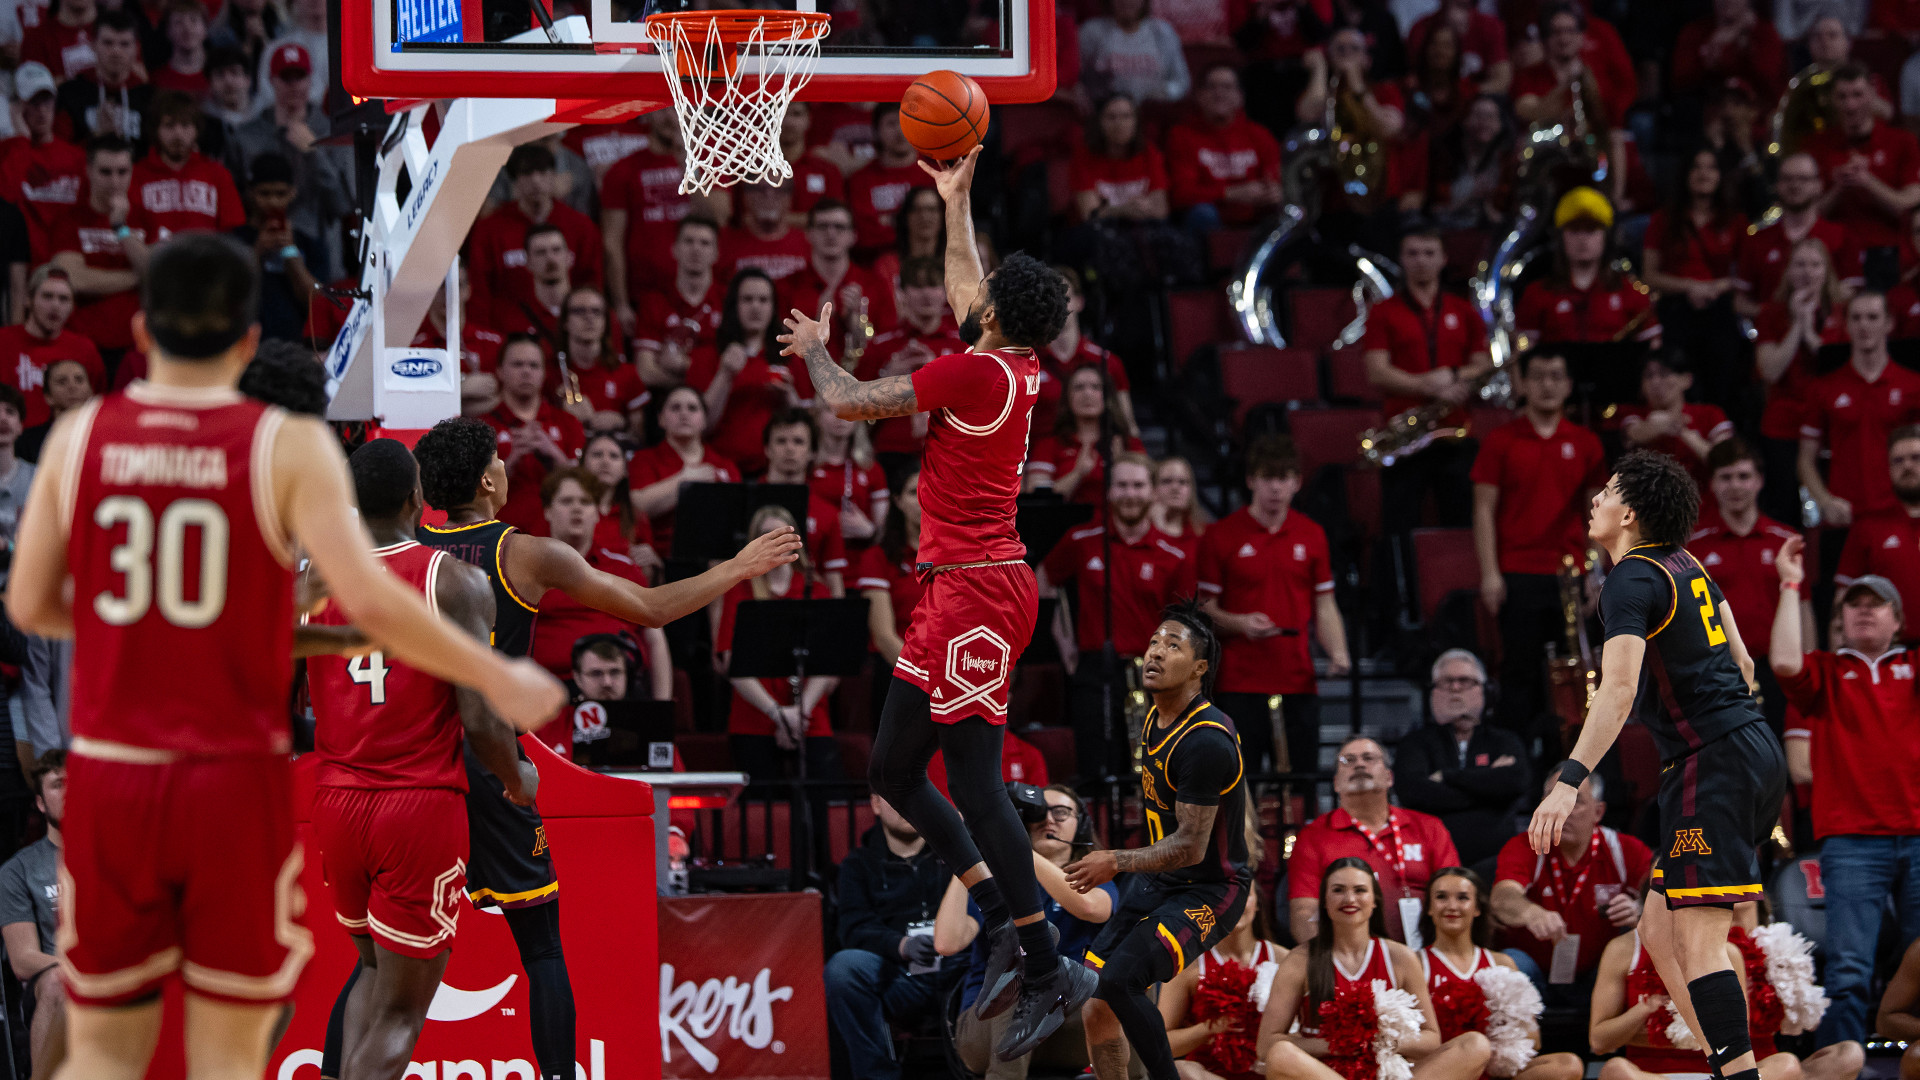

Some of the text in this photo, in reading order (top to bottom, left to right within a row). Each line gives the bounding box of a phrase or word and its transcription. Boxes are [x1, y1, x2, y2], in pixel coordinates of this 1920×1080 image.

[407, 158, 439, 231] LEGACY
[101, 443, 228, 491] TOMINAGA
[93, 494, 230, 629] 30
[1690, 577, 1727, 647] 2
[346, 650, 392, 705] 4
[961, 649, 999, 674] Huskers
[580, 706, 602, 729] N
[1669, 828, 1712, 858] M
